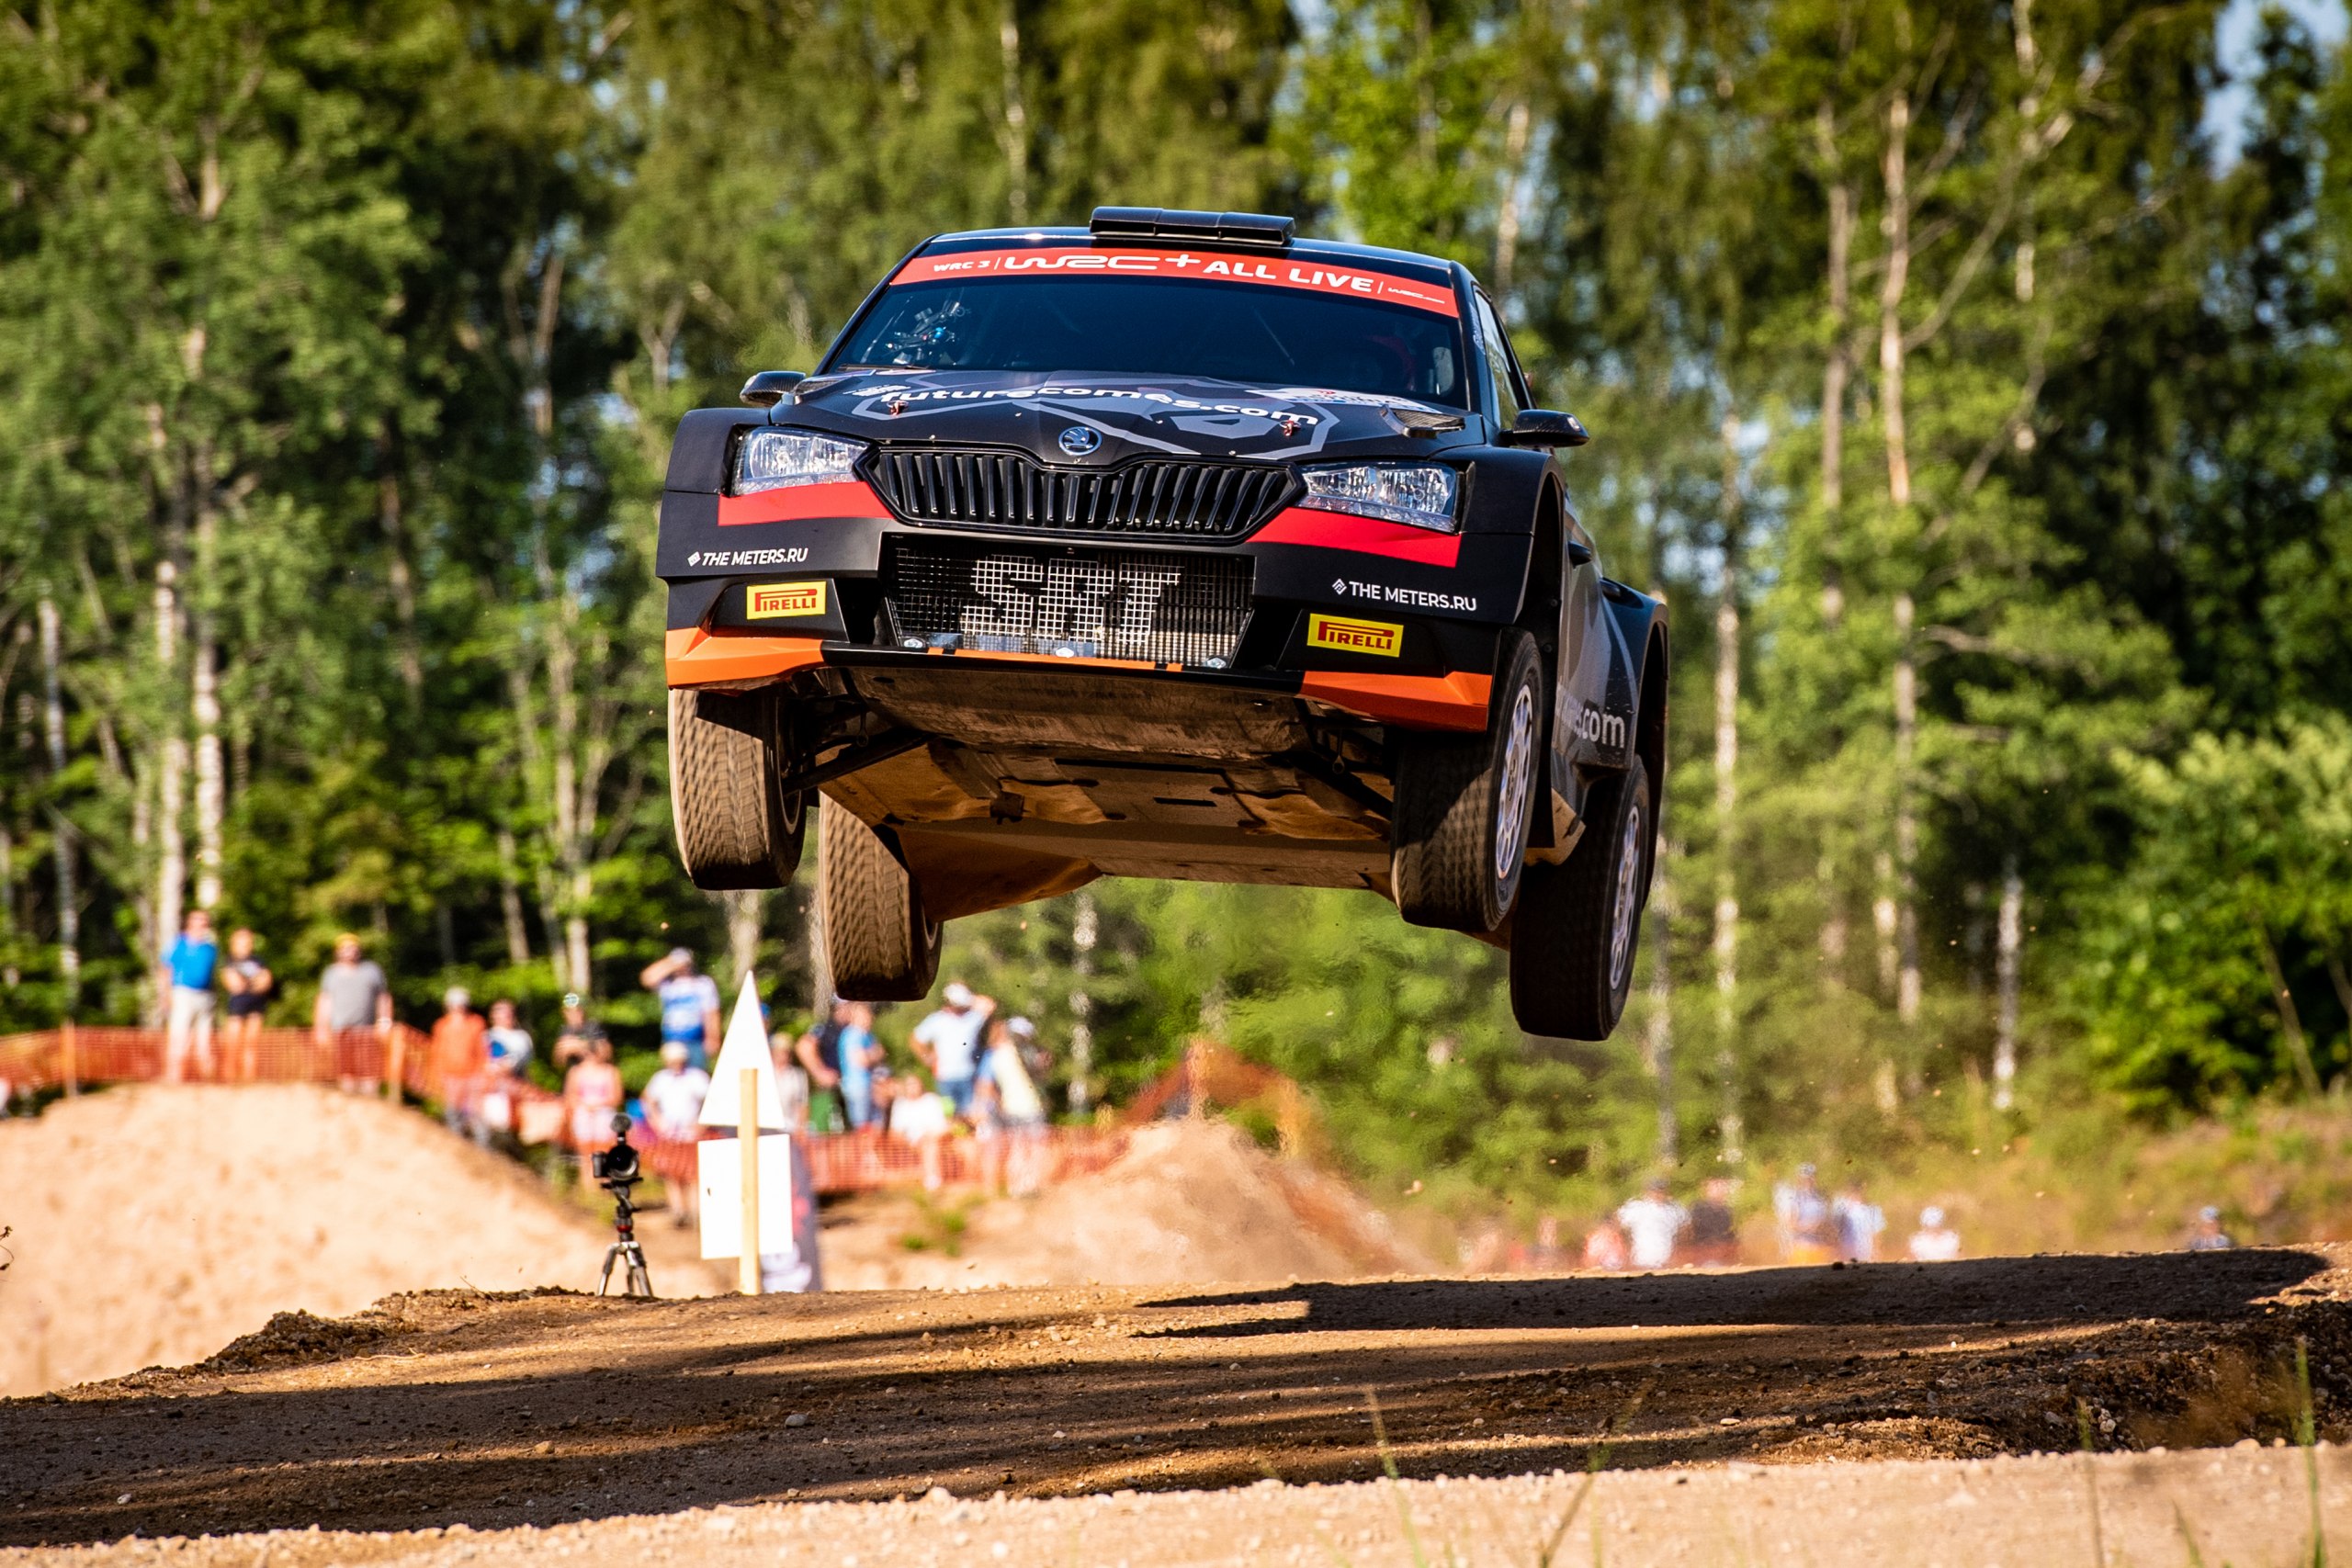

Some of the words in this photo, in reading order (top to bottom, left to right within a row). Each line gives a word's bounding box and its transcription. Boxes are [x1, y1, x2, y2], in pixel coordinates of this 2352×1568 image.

[933, 261, 972, 272] WRC
[978, 259, 990, 269] 3
[1203, 261, 1277, 279] ALL
[1288, 267, 1373, 293] LIVE
[702, 551, 731, 566] THE
[731, 547, 808, 566] METERS.RU
[754, 588, 818, 613] PIRELLI
[1349, 581, 1382, 601] THE
[1385, 586, 1477, 612] METERS.RU
[1317, 621, 1395, 650] PIRELLI
